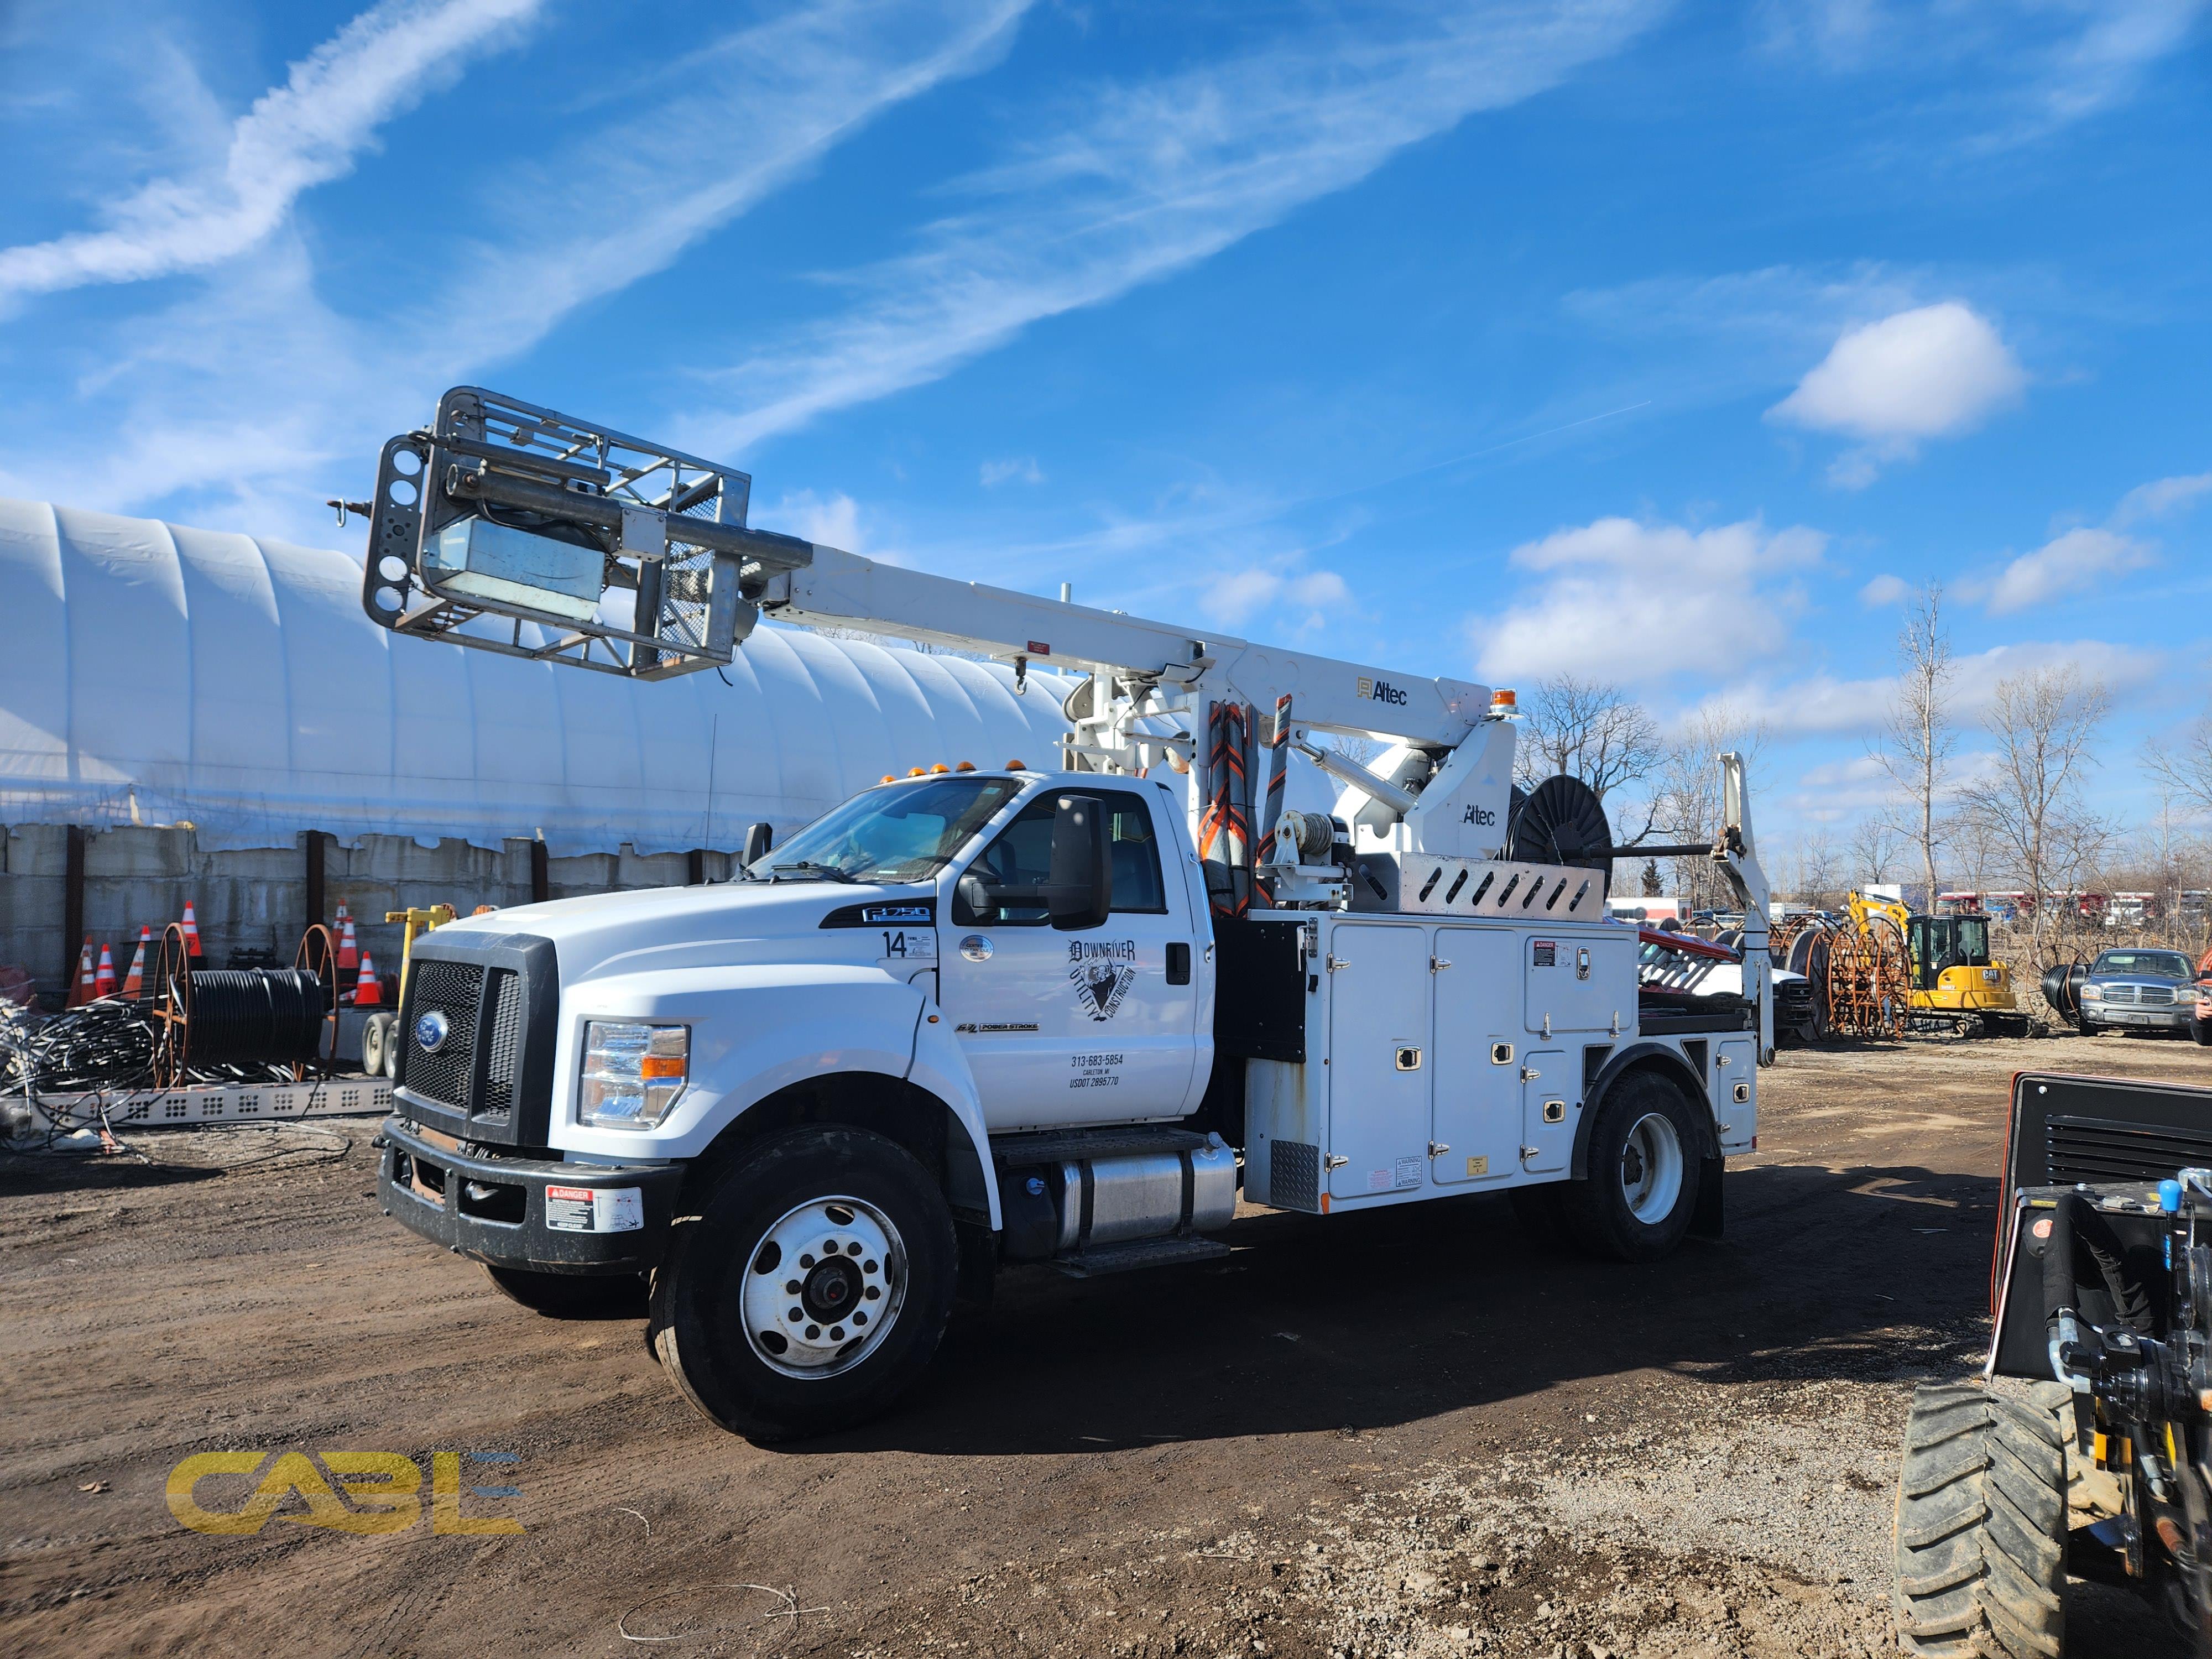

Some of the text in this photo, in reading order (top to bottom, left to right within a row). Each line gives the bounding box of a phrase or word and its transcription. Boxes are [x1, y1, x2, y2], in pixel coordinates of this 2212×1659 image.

[1373, 681, 1407, 706] Altec
[1463, 804, 1495, 826] Altec
[882, 931, 907, 957] 14
[1068, 939, 1135, 963] DOWNRIVER
[1983, 969, 1998, 980] CAT
[1070, 968, 1098, 1017] UTILITY
[1104, 966, 1136, 1018] CONSTRUCTION
[956, 1024, 978, 1033] 6.7L
[1071, 1054, 1123, 1067] 313-683-5854
[1070, 1076, 1119, 1088] USDOT 2895770
[1401, 1177, 1421, 1186] WARNING
[559, 1190, 588, 1199] DANGER
